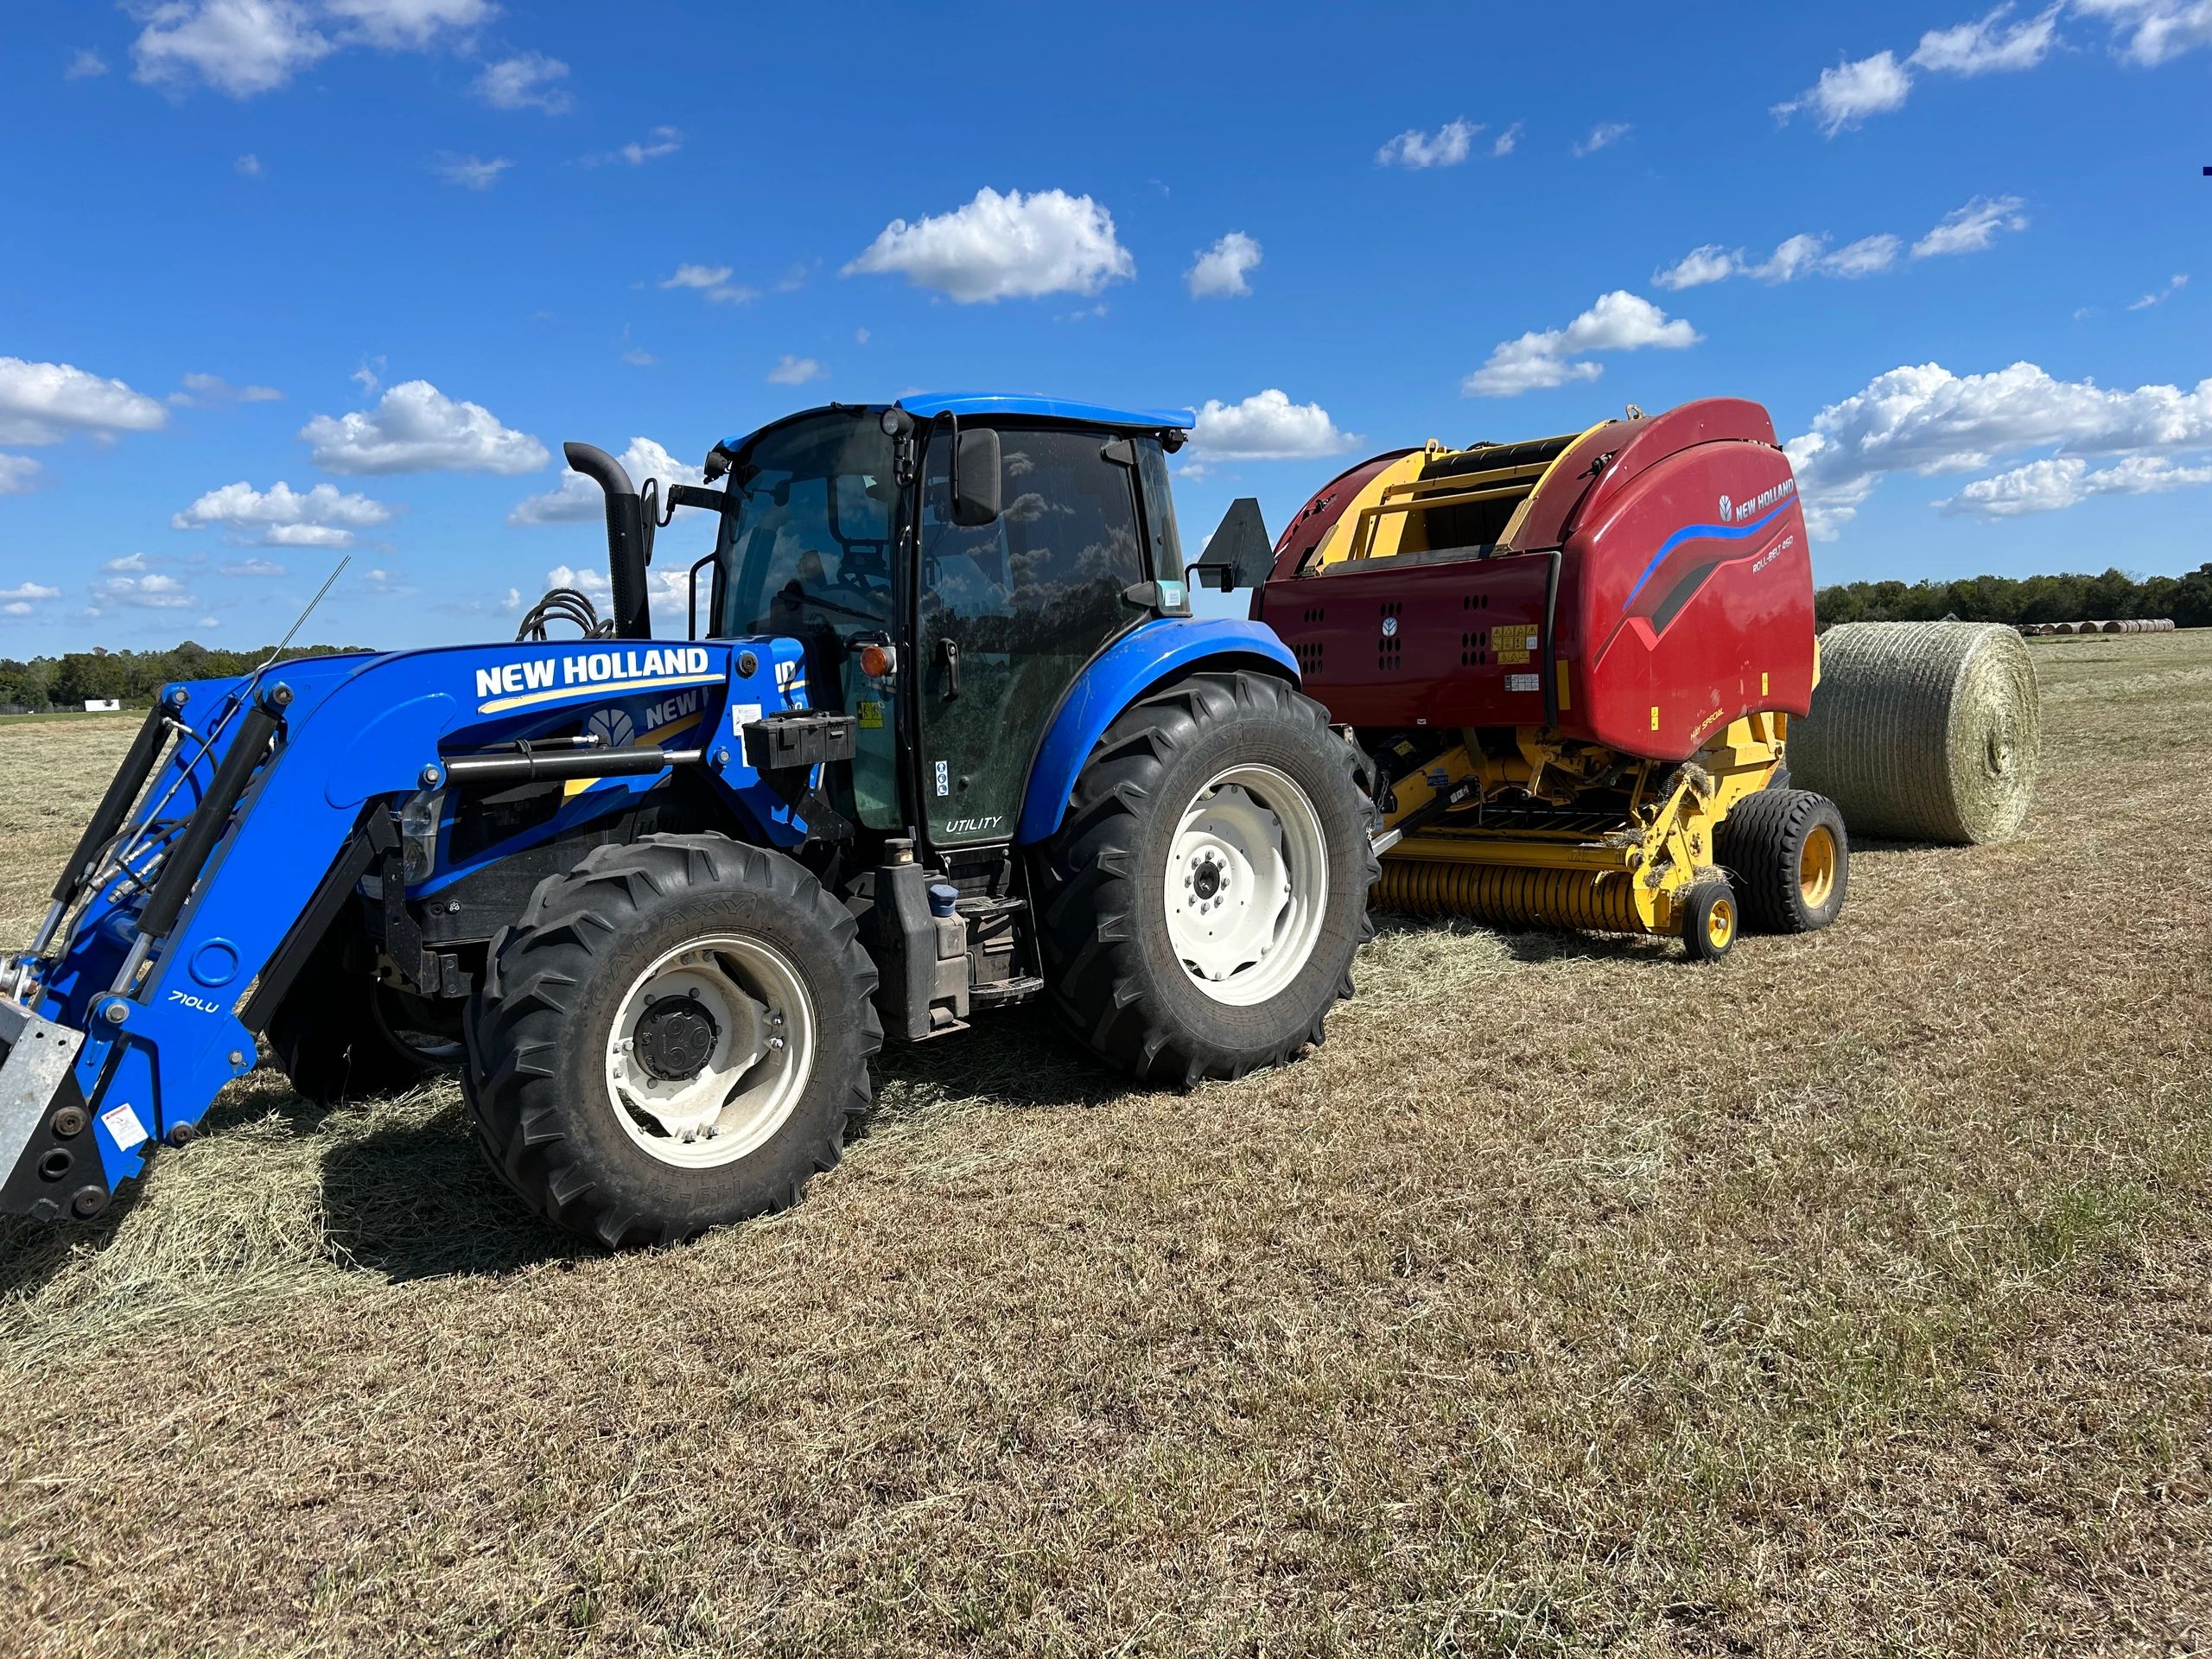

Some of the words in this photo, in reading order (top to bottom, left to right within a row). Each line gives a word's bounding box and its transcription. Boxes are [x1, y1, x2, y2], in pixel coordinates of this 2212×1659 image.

[1736, 498, 1756, 522] NEW
[1758, 478, 1794, 510] HOLLAND
[1752, 544, 1781, 575] ROLL-BELT
[477, 658, 556, 698] NEW
[563, 648, 709, 684] HOLLAND
[646, 690, 697, 729] NEW
[946, 816, 1002, 833] UTILITY
[168, 990, 219, 1013] 710LU
